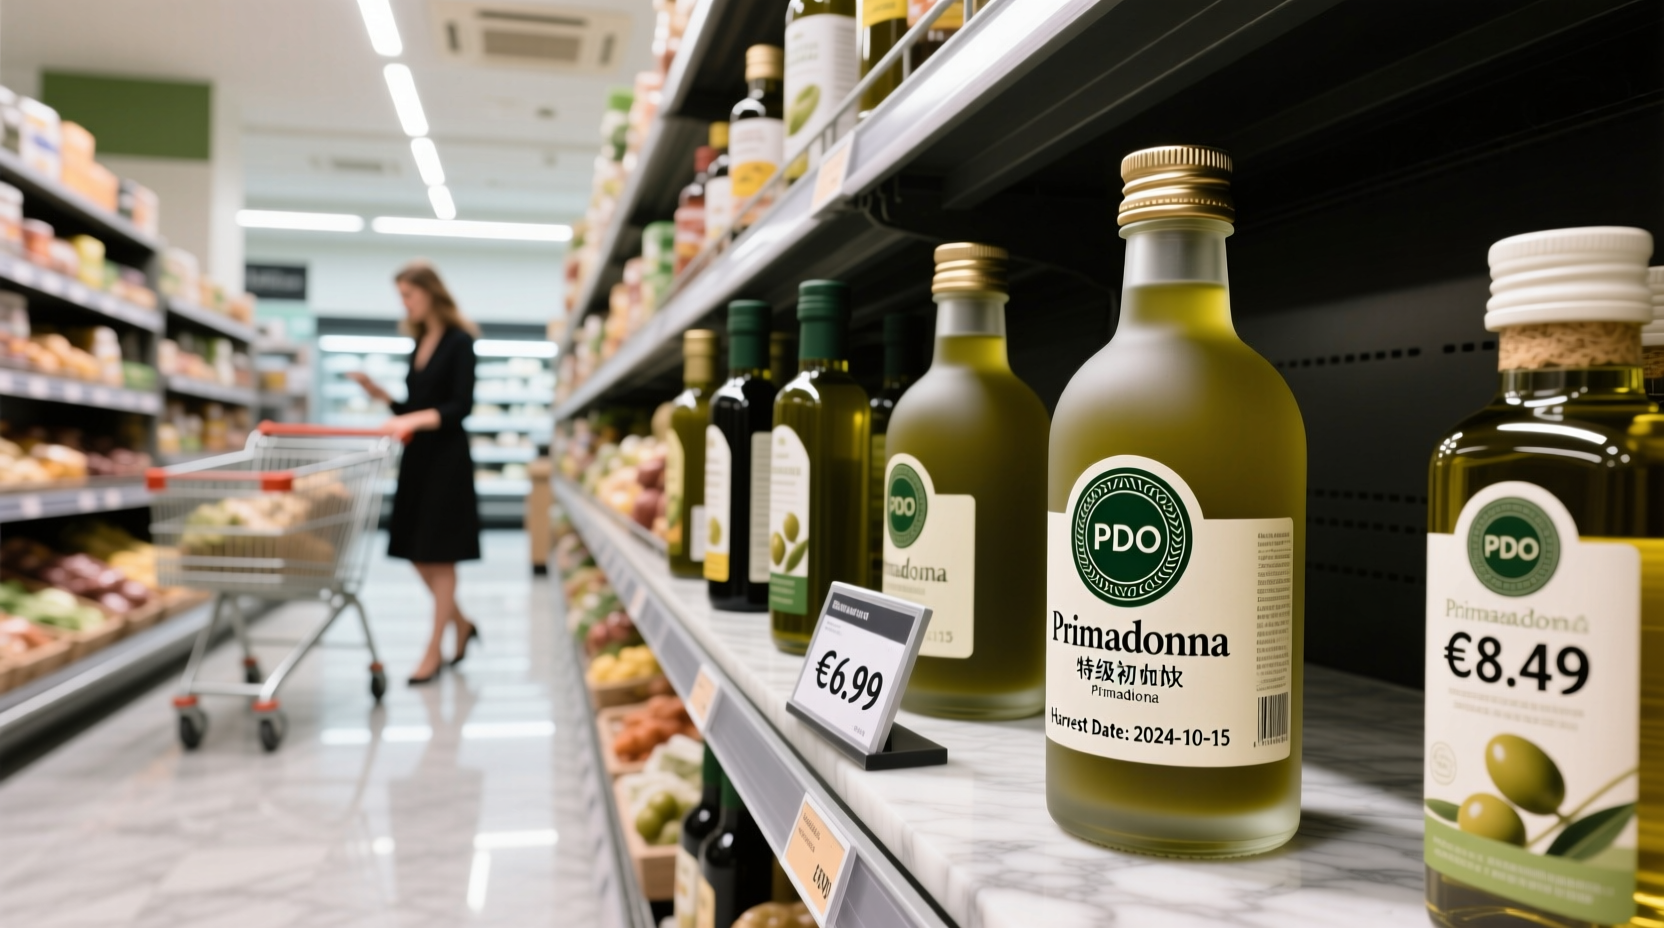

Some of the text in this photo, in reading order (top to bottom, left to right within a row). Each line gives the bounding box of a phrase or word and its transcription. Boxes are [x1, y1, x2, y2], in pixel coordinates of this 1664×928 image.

[1093, 522, 1162, 554] PDO
[1484, 534, 1540, 561] PDO
[1052, 610, 1231, 657] Primadonna
[815, 650, 883, 711] €6.99
[1444, 631, 1590, 695] €8.49
[1092, 718, 1129, 741] Date:
[1133, 725, 1231, 746] 2024-10-15
